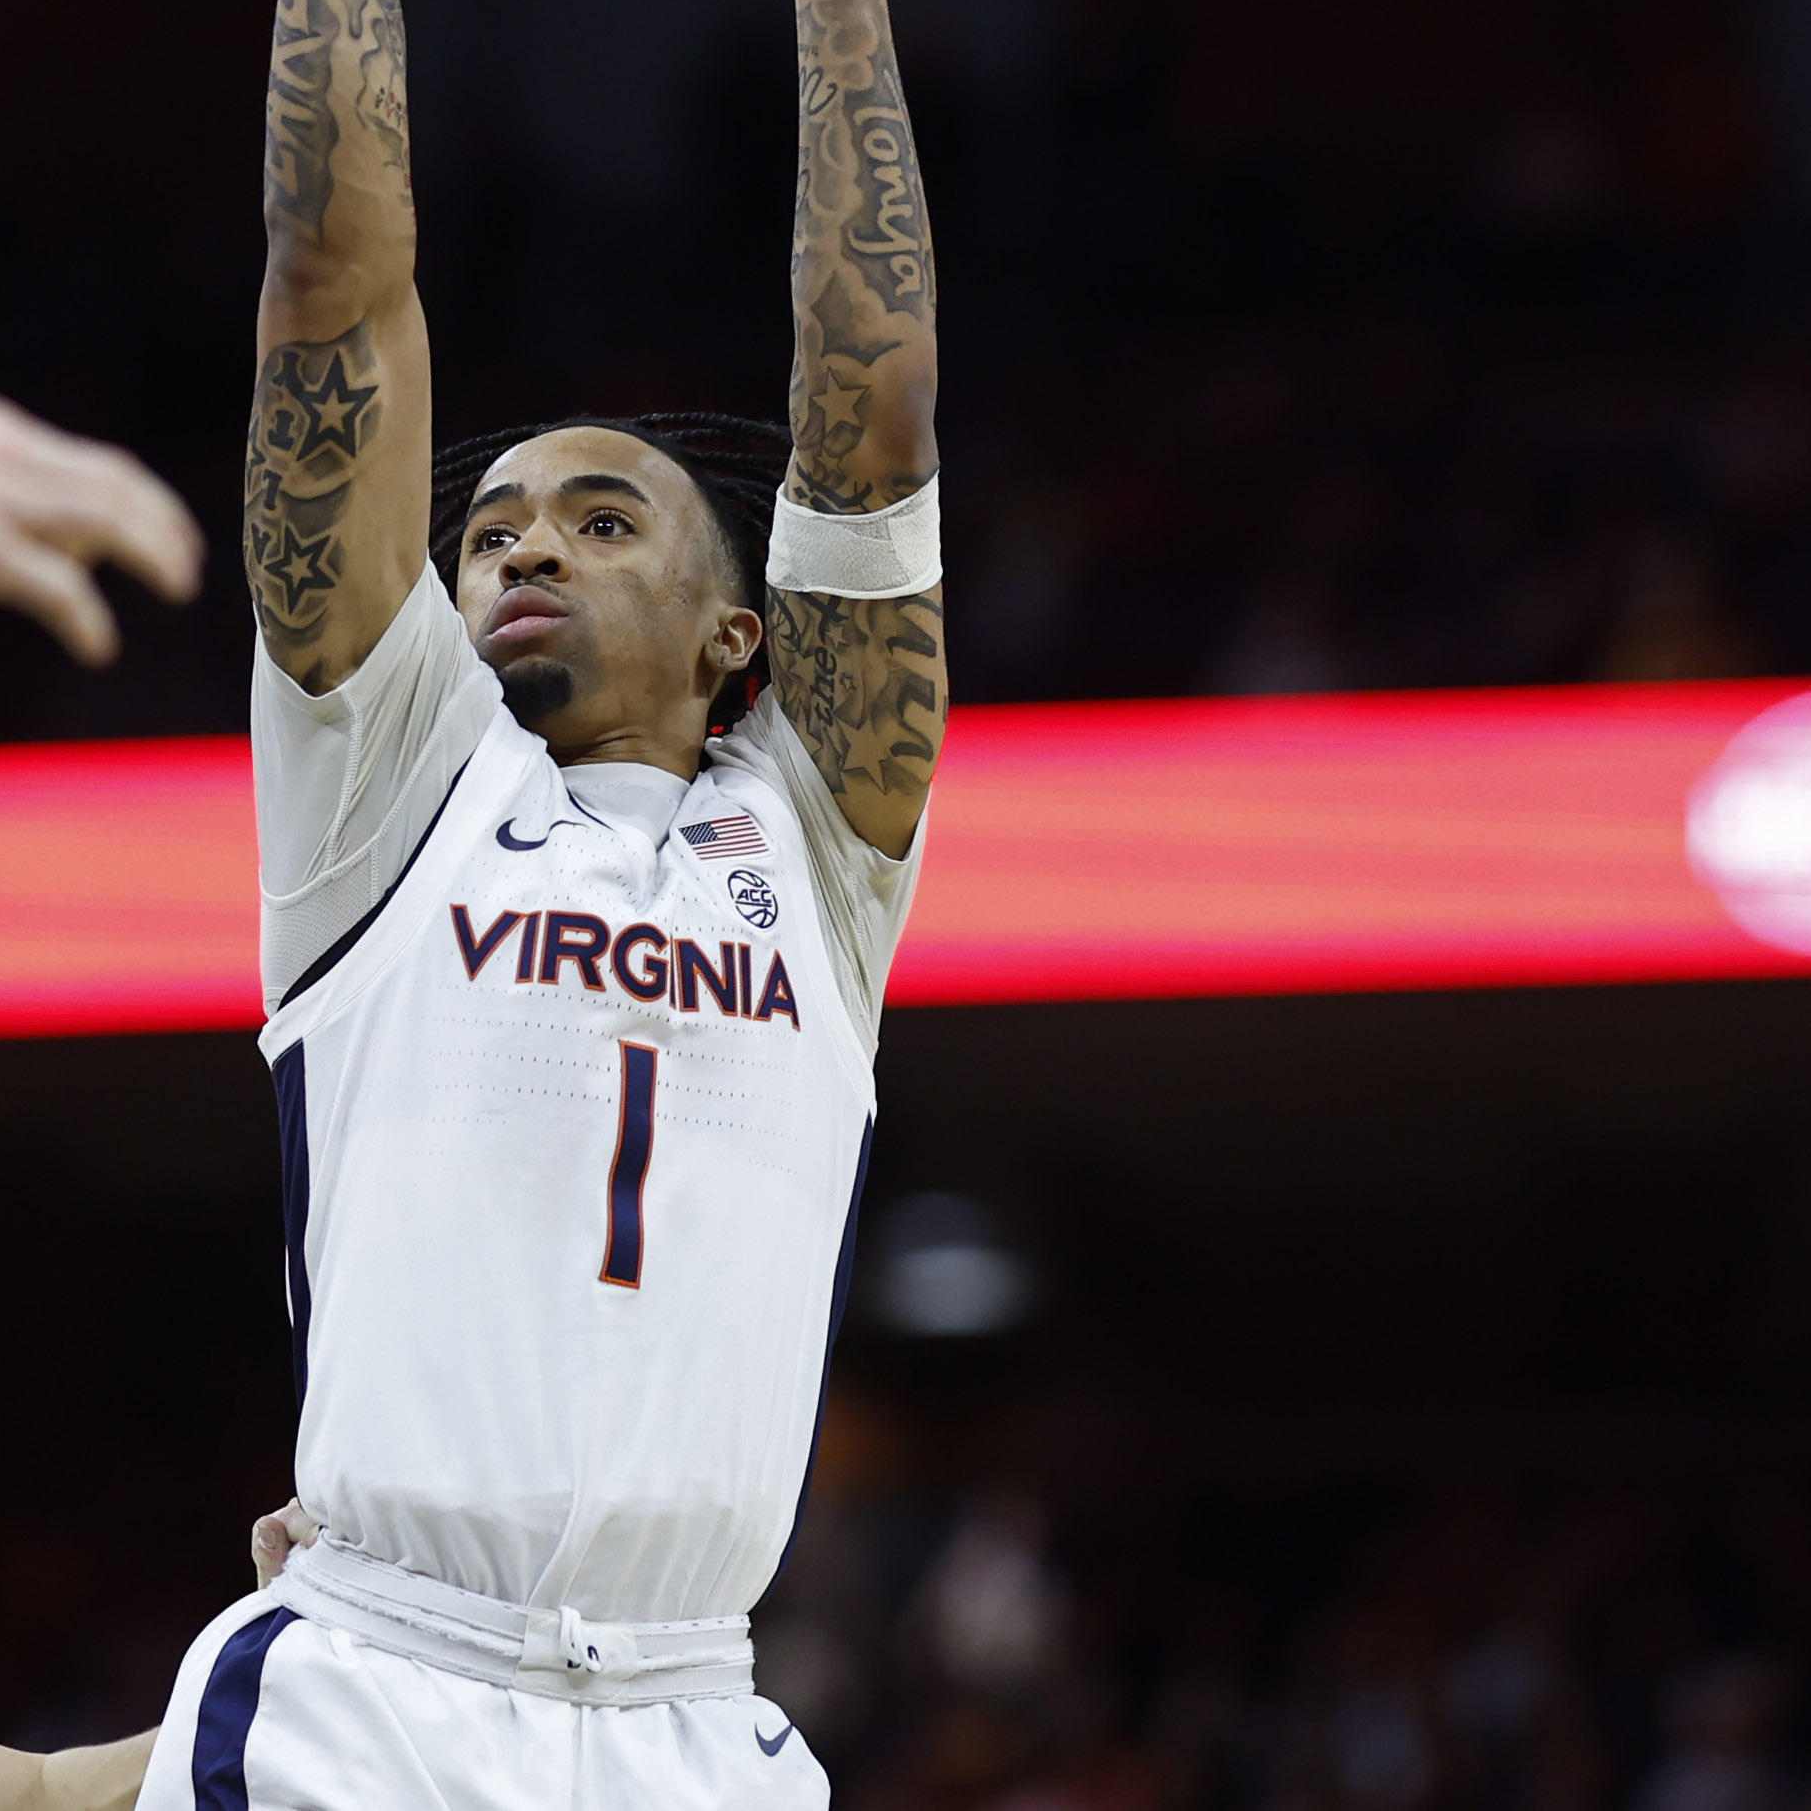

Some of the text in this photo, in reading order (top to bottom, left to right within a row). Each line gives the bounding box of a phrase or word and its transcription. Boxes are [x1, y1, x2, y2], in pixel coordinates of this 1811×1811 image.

[736, 888, 773, 904] ACC
[449, 902, 802, 1032] VIRGINIA
[597, 1039, 660, 1290] 1
